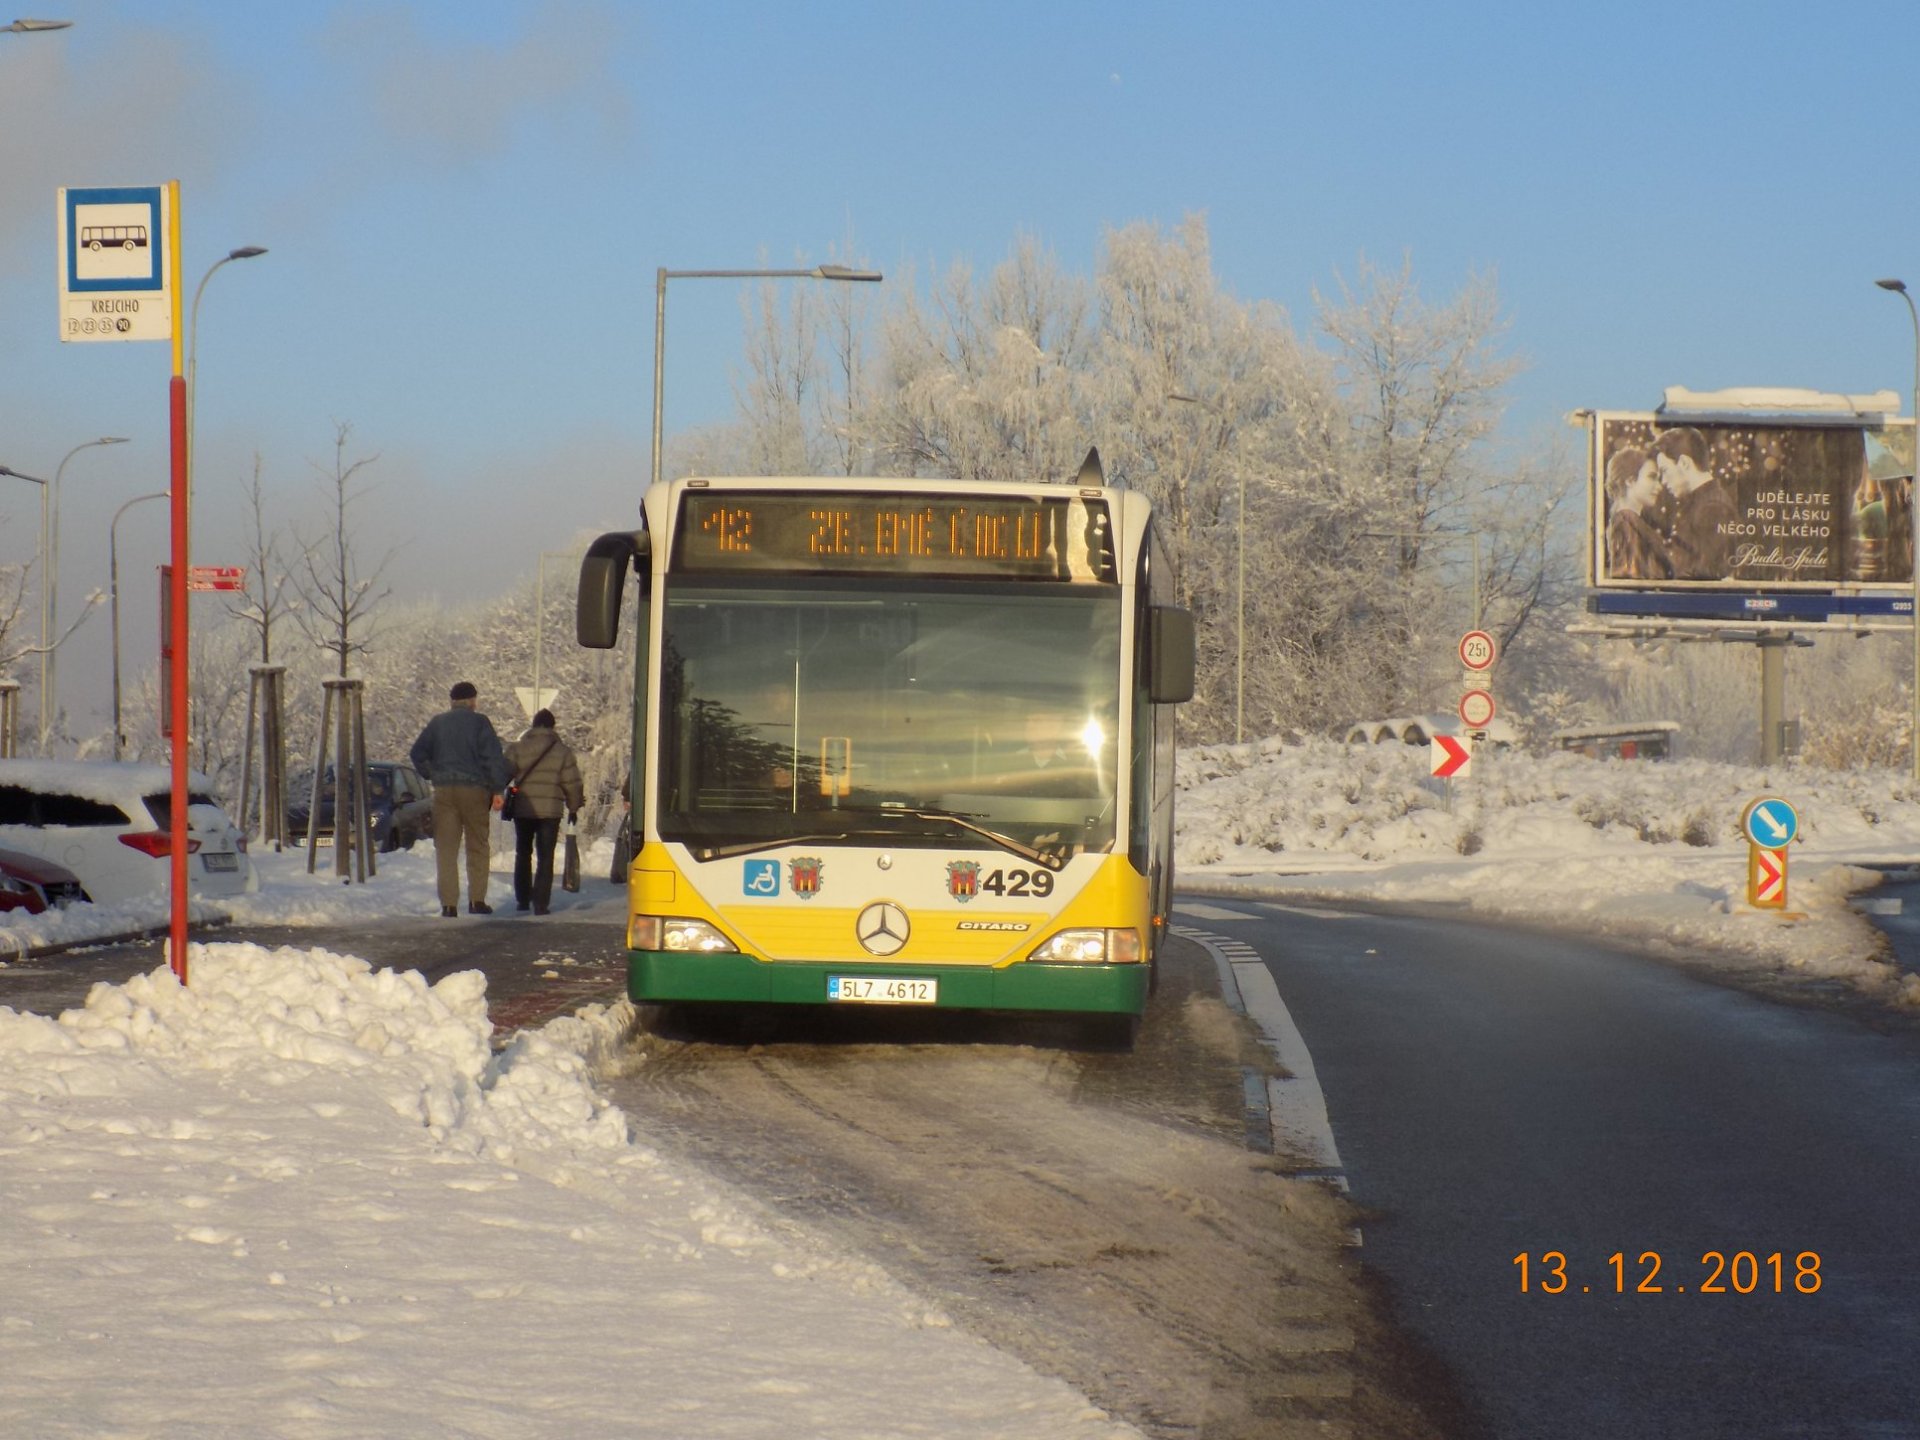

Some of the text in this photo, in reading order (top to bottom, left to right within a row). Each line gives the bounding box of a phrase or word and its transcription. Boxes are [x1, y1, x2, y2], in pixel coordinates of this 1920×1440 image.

[1756, 489, 1831, 505] UDĚLEJTE
[1747, 507, 1830, 521] PRO LÁSKU
[1717, 520, 1831, 538] NĚCO VELKÉHO
[1468, 642, 1487, 658] 25t
[982, 868, 1055, 898] 429
[959, 922, 1028, 931] CITARO
[843, 981, 928, 1000] 5L7 4612
